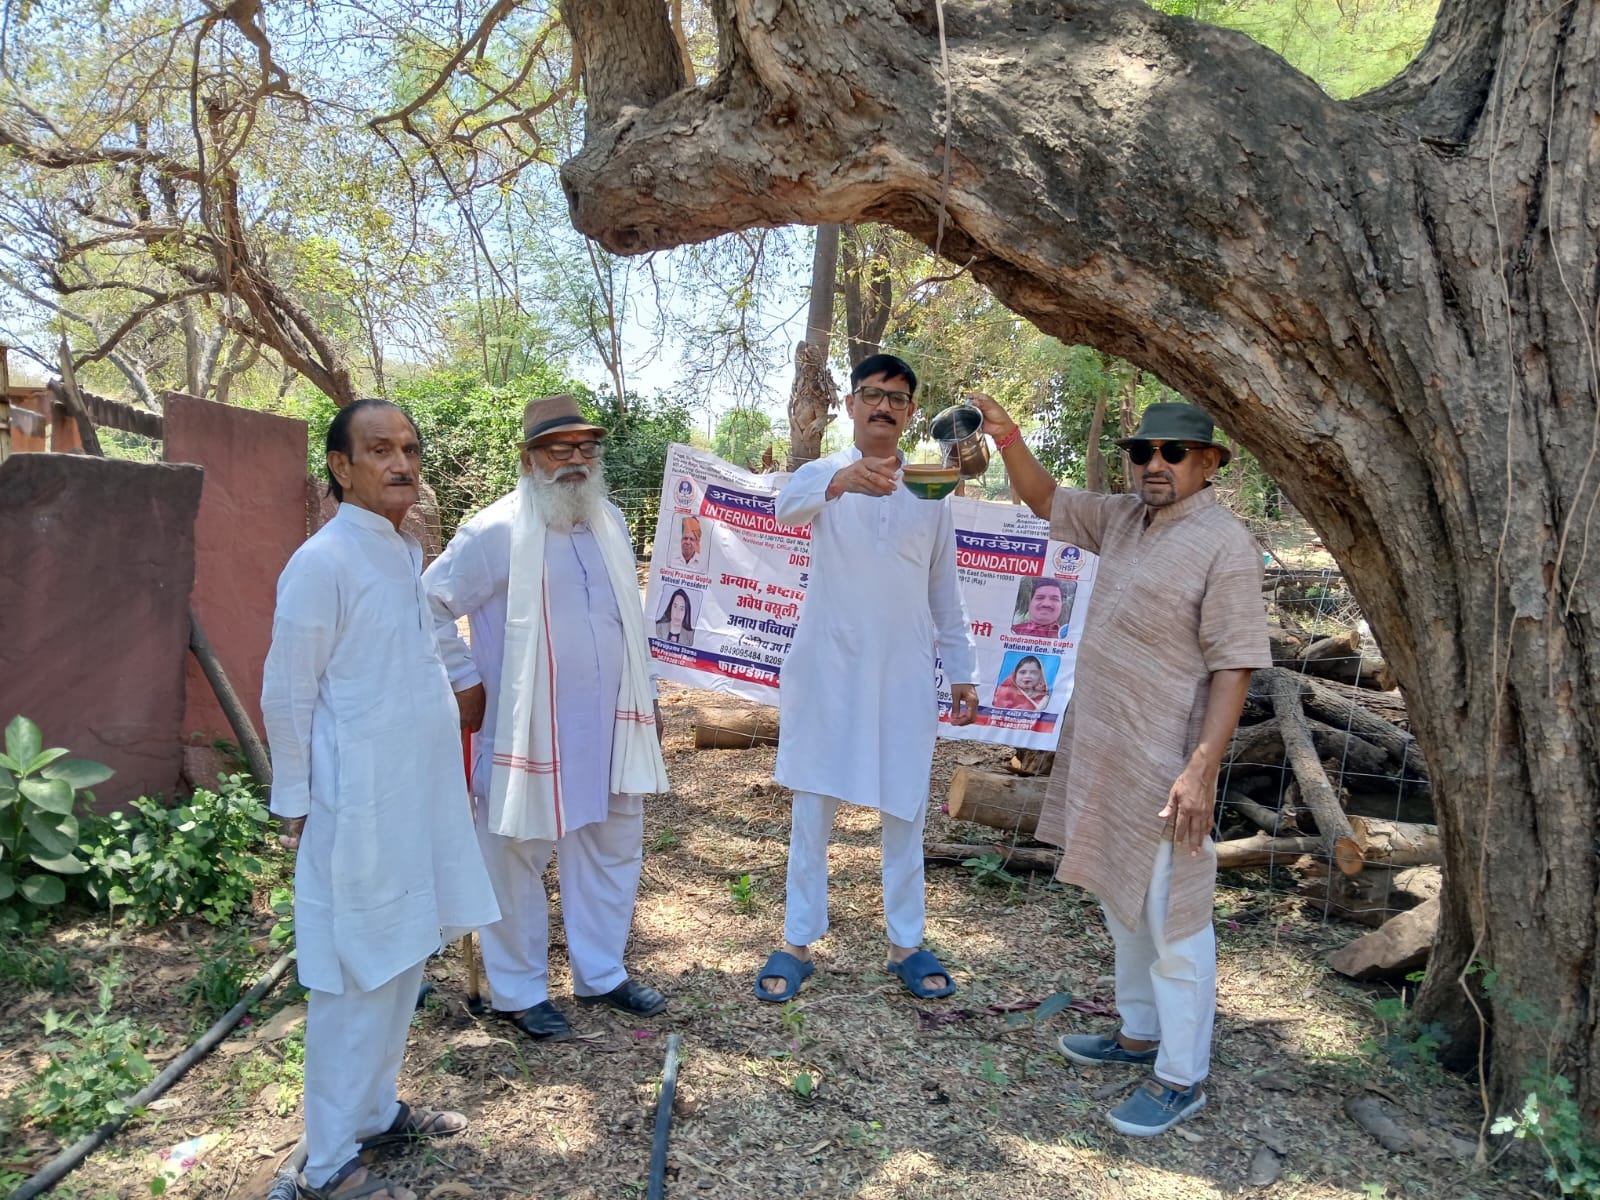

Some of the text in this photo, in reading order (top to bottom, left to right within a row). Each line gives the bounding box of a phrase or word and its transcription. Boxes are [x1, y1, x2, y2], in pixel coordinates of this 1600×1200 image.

[704, 503, 798, 536] INTERNATIONAL
[962, 535, 1041, 553] फाउंडेशन
[956, 551, 1039, 574] FOUNDATION
[681, 579, 708, 590] President
[766, 584, 805, 601] भ्रष्टाच
[1000, 634, 1074, 649] Chandramohan Gupta
[1003, 642, 1033, 652] National
